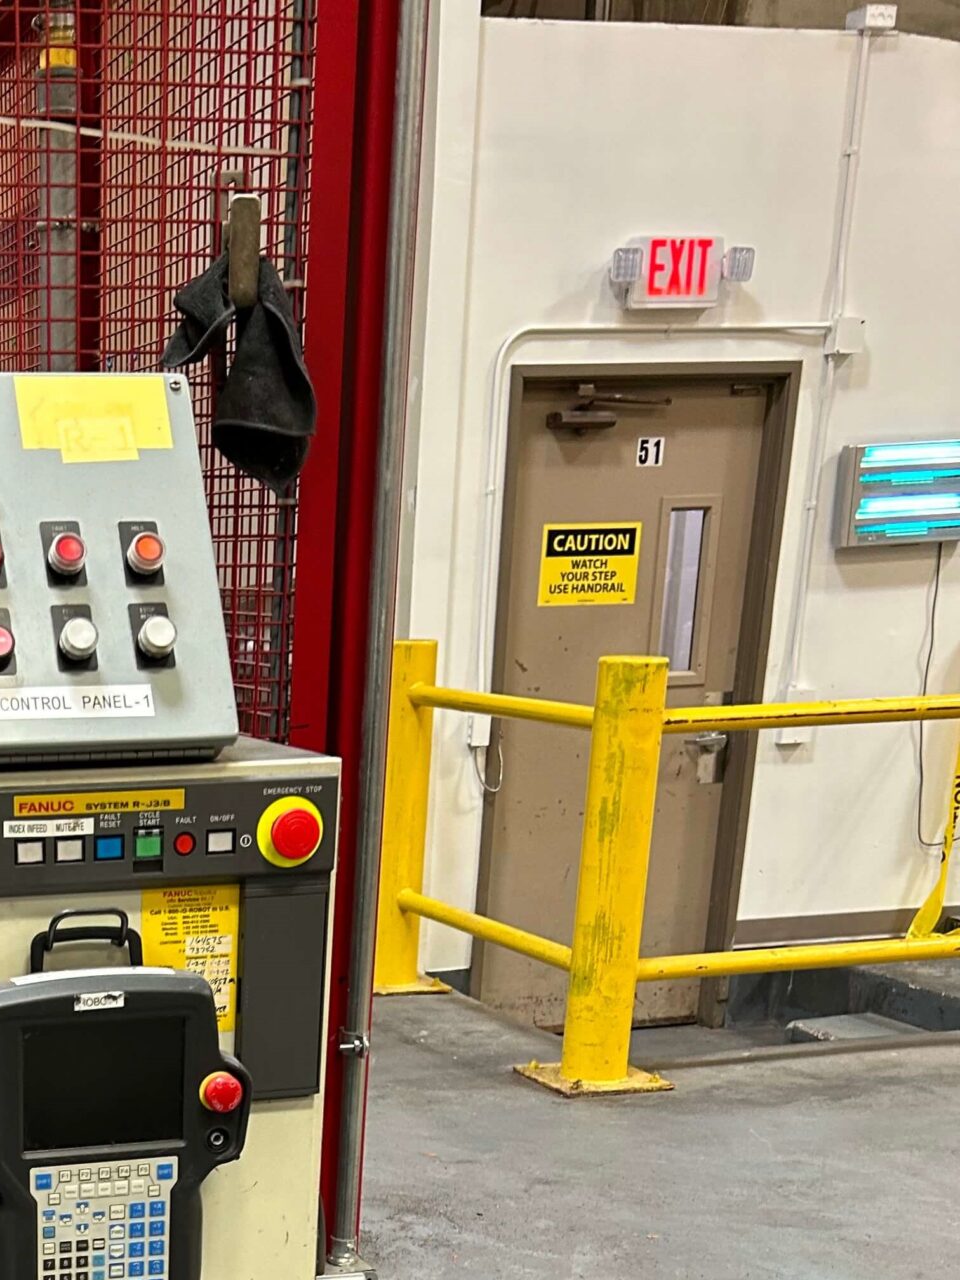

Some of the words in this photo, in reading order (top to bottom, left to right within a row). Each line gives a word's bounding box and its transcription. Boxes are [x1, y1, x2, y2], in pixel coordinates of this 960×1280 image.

[646, 239, 713, 296] EXIT
[639, 439, 662, 465] 51
[553, 533, 630, 552] CAUTION
[571, 559, 608, 570] WATCH
[560, 572, 589, 582] YOUR
[592, 571, 617, 581] STEP
[549, 584, 569, 594] USE
[571, 583, 625, 593] HANDRAIL
[82, 694, 150, 709] PANEL-1
[263, 786, 302, 796] EMERGENCY
[305, 785, 322, 794] STOP
[18, 801, 74, 814] FANUC
[85, 802, 129, 811] SYSTEM
[99, 812, 121, 821] FAULT
[138, 811, 160, 819] CYCLE
[175, 815, 197, 825] FAULT
[209, 813, 235, 824] ON/OFF
[99, 820, 121, 829] RESET
[138, 818, 160, 827] START
[8, 824, 25, 834] INDEX
[26, 824, 48, 834] INFEED
